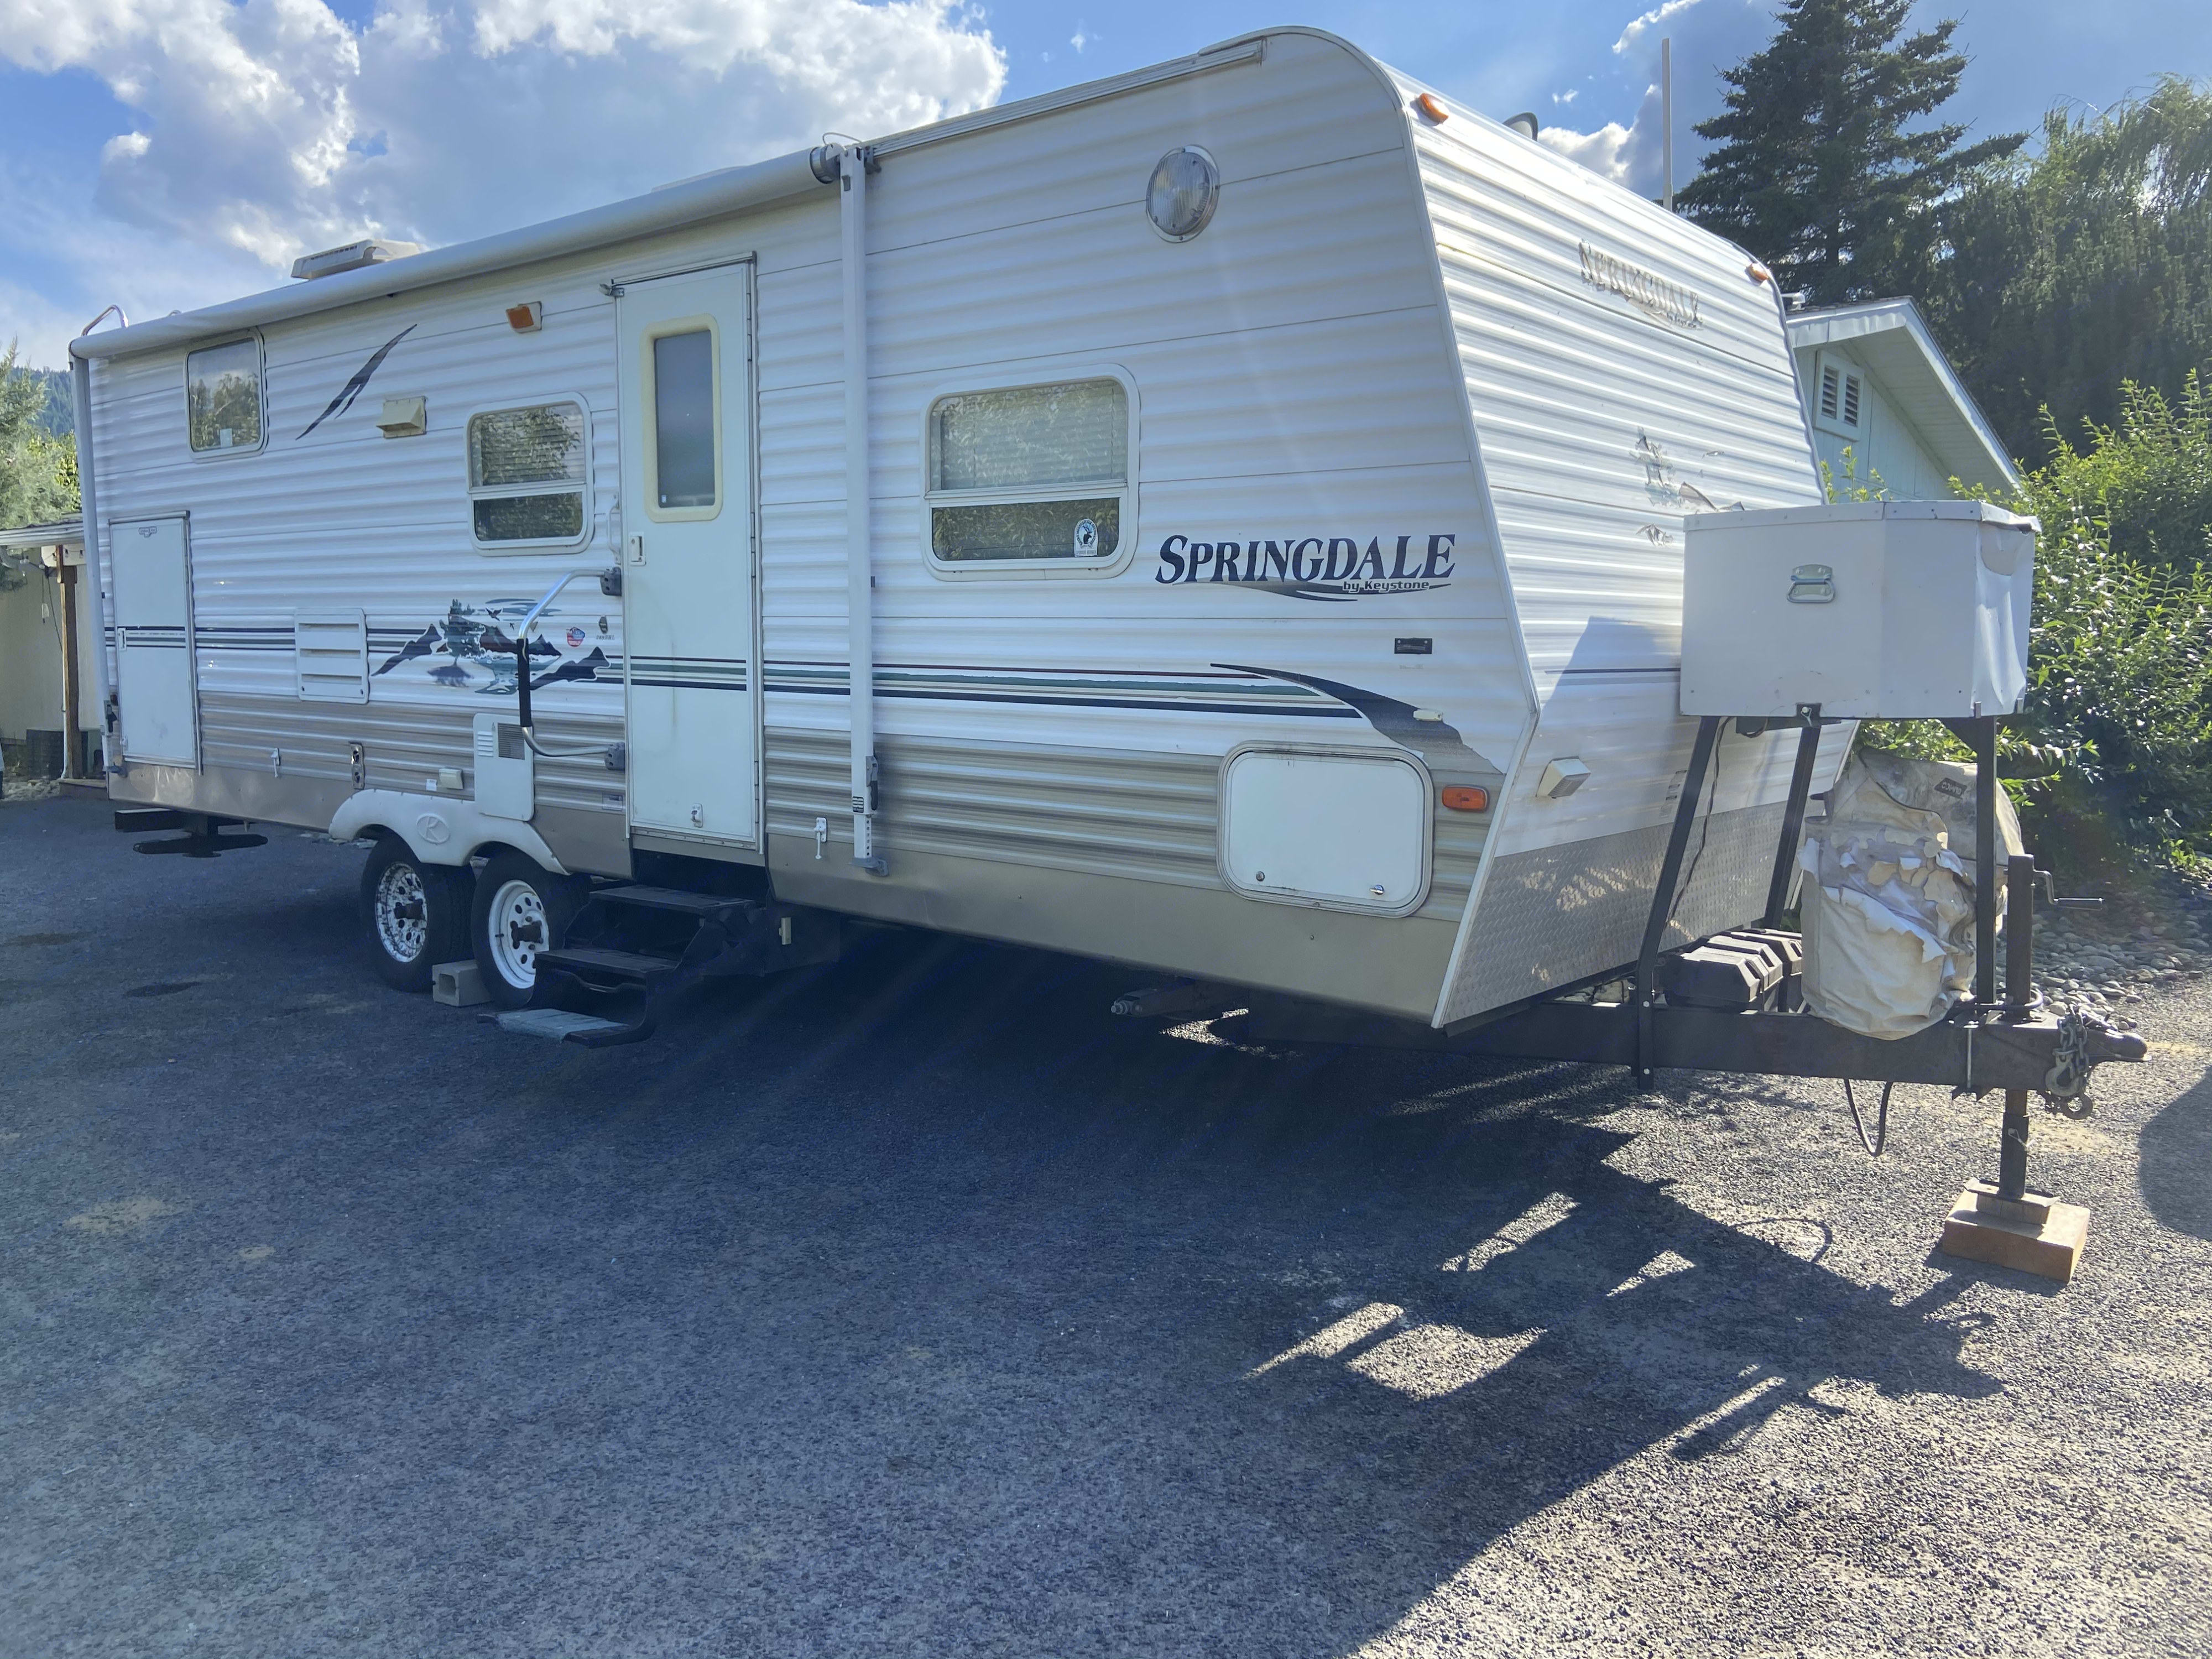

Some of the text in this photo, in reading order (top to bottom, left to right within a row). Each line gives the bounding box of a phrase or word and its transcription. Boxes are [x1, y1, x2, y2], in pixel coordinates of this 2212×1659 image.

[1155, 534, 1455, 584] SPRINGDALE
[1343, 581, 1430, 592] by Keystone
